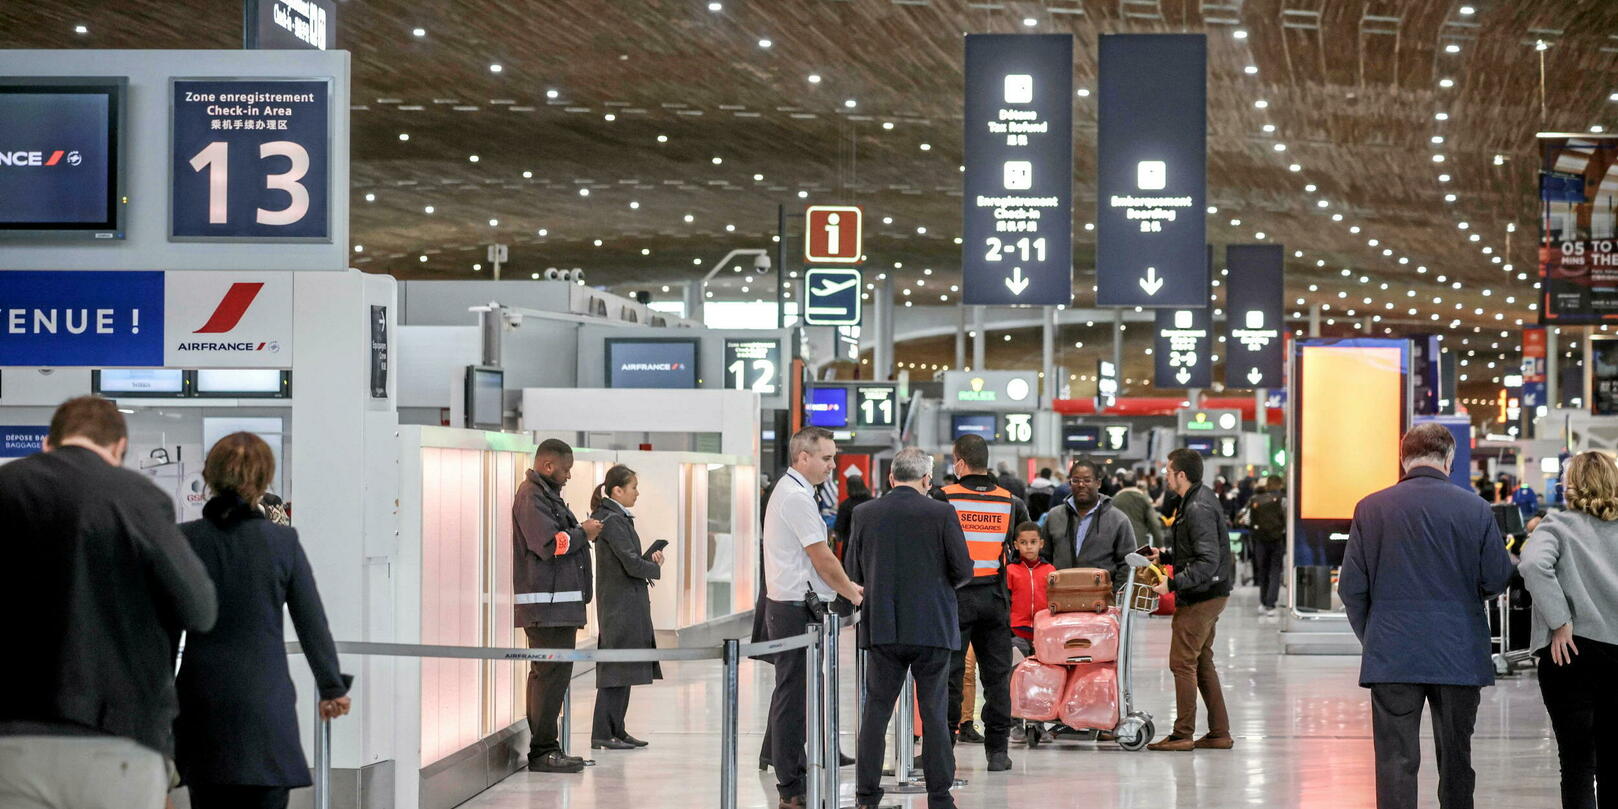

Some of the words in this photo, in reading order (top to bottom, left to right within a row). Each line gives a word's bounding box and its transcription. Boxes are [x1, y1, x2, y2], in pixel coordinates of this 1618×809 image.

[185, 92, 216, 102] Zone
[220, 92, 314, 104] enregistrement
[207, 105, 259, 116] Check-in
[263, 106, 292, 116] Area
[189, 141, 311, 226] 13
[985, 237, 1046, 261] 2-11
[1561, 241, 1585, 256] 05
[1591, 240, 1612, 253] TO
[0, 309, 114, 334] ENUE
[178, 342, 253, 351] AIRFRANCE
[621, 363, 671, 371] AIRFRANCE
[728, 359, 775, 393] 12
[861, 399, 892, 424] 11
[1006, 422, 1032, 442] 10
[961, 513, 1002, 524] SECURITE
